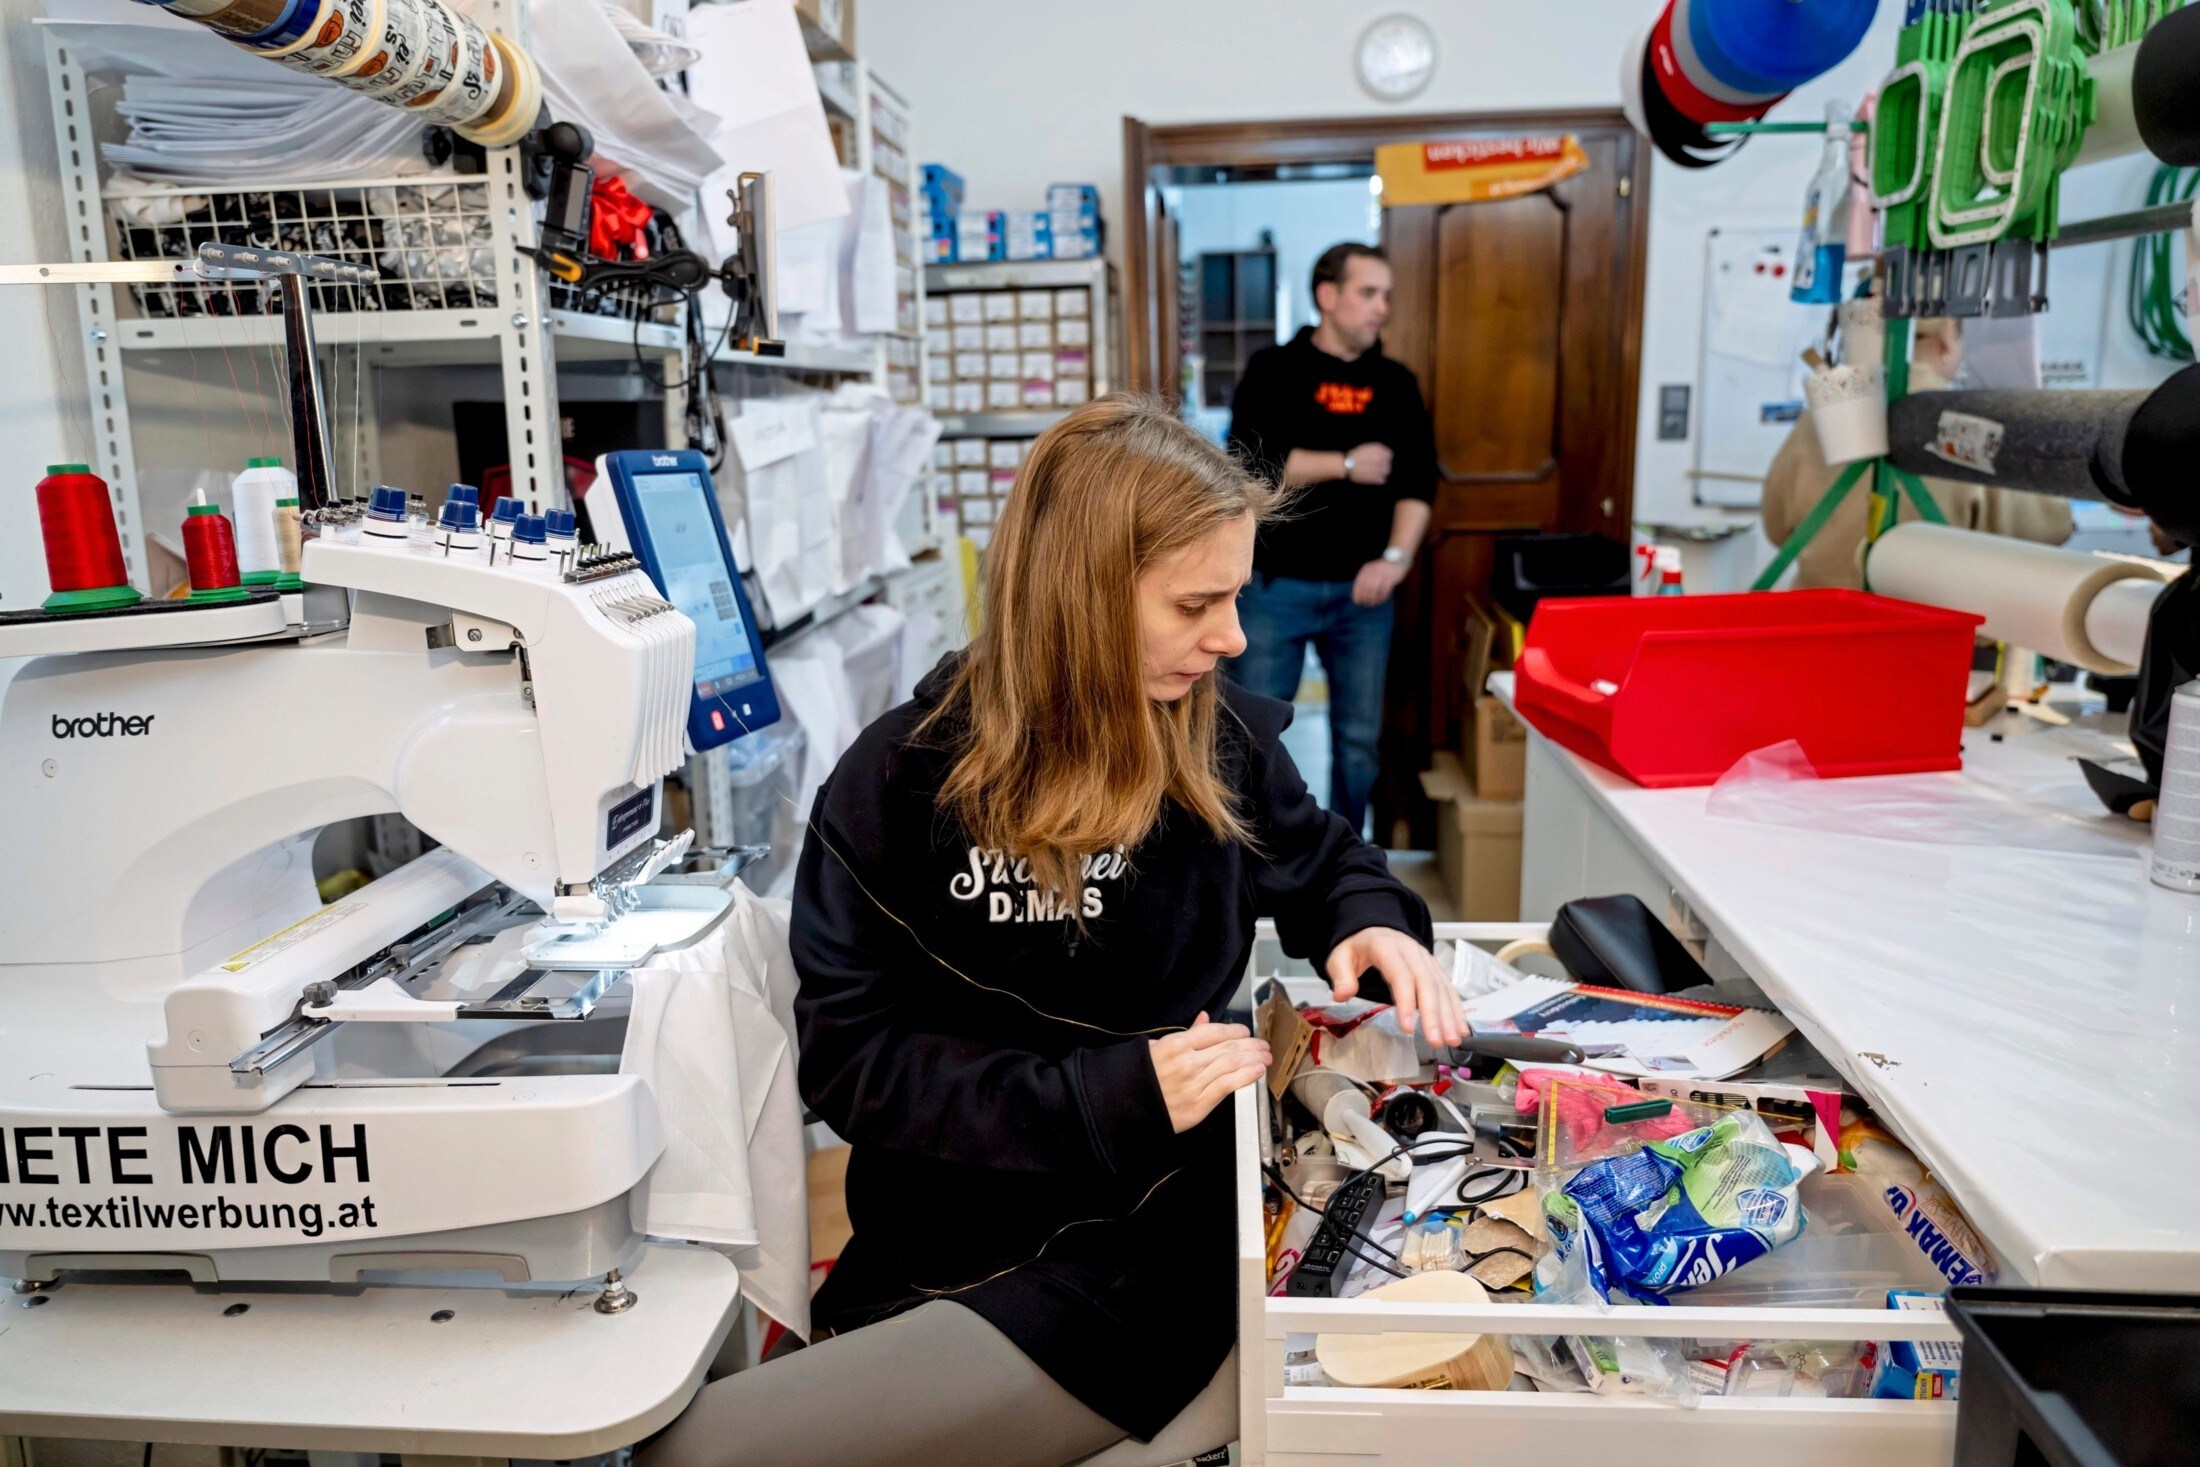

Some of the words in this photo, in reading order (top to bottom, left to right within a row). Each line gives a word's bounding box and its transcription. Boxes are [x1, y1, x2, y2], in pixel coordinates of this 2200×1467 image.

[652, 455, 678, 467] brother
[52, 711, 154, 739] brother
[177, 1124, 371, 1185] MICH
